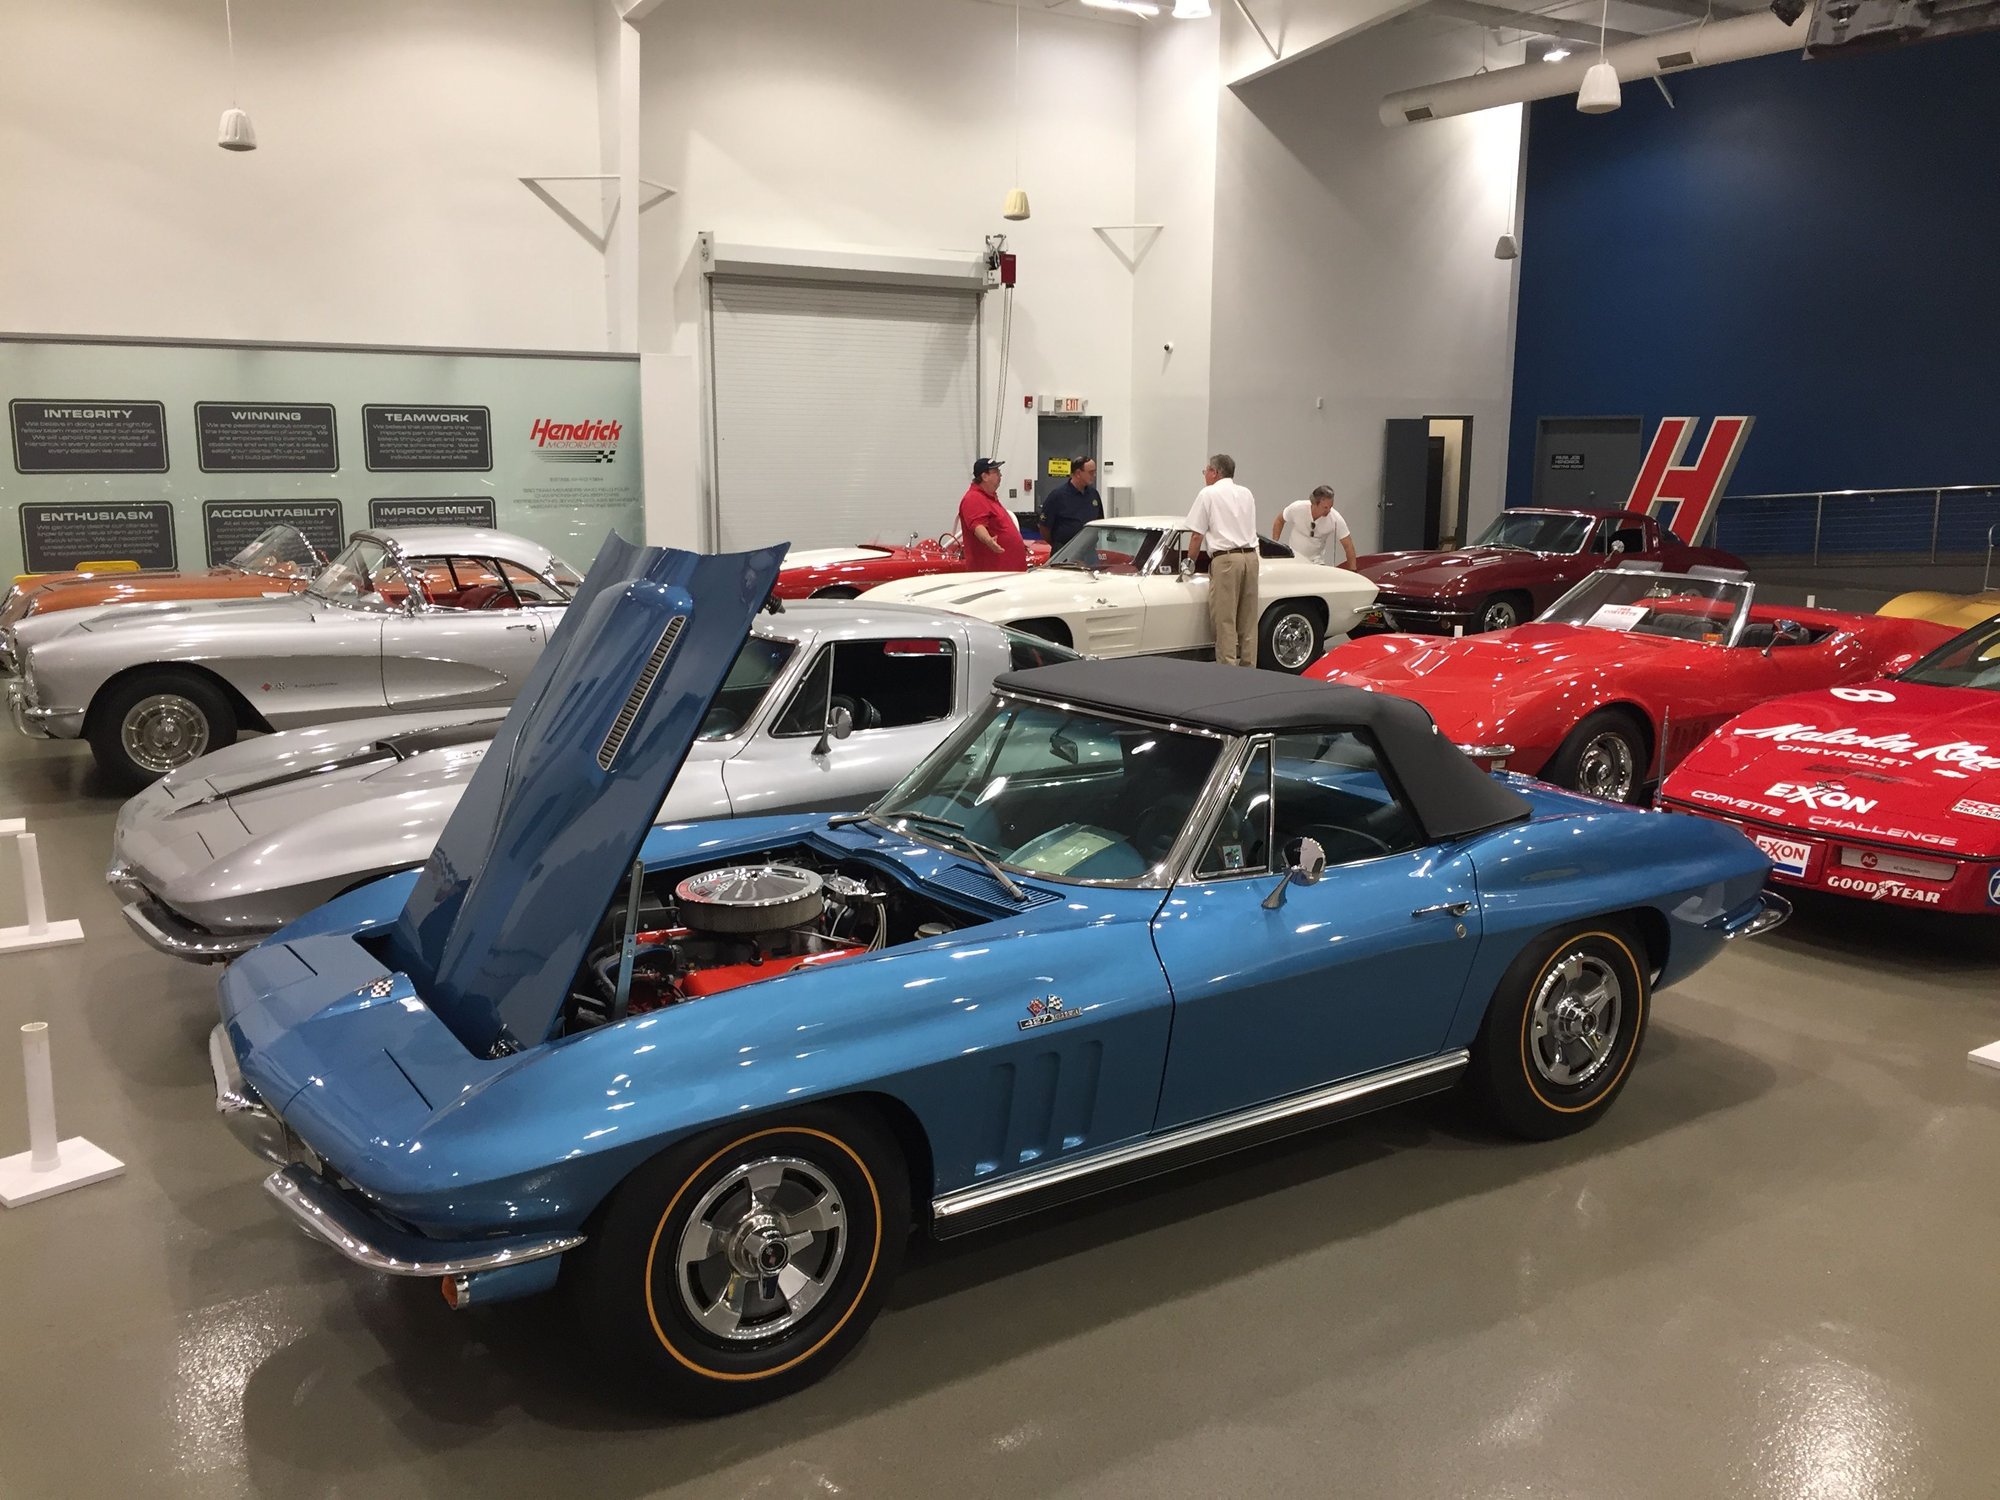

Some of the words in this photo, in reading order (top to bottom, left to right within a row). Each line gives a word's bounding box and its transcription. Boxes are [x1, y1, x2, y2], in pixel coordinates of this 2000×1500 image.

[1065, 398, 1079, 411] EXIT
[44, 409, 133, 419] INTEGRITY
[231, 411, 302, 421] WINNING
[384, 413, 470, 423] TEAMWORK
[529, 418, 623, 448] Hendrick
[546, 441, 618, 449] MOTORSPORTS
[1617, 416, 1749, 548] H
[41, 511, 153, 522] ENTHUSIASM
[210, 507, 337, 519] ACCOUNTABILITY
[380, 505, 485, 516] IMPROVEMENT
[1733, 723, 1919, 754] Malcolm
[1776, 744, 1913, 768] CHEVROLET
[1763, 781, 1879, 814] EXXON
[1953, 805, 1975, 813] PRO
[1690, 789, 1786, 817] CORVETTE
[1808, 815, 1959, 847] CHALLENGE
[1758, 839, 1806, 862] EXXON
[1862, 855, 1877, 865] AC
